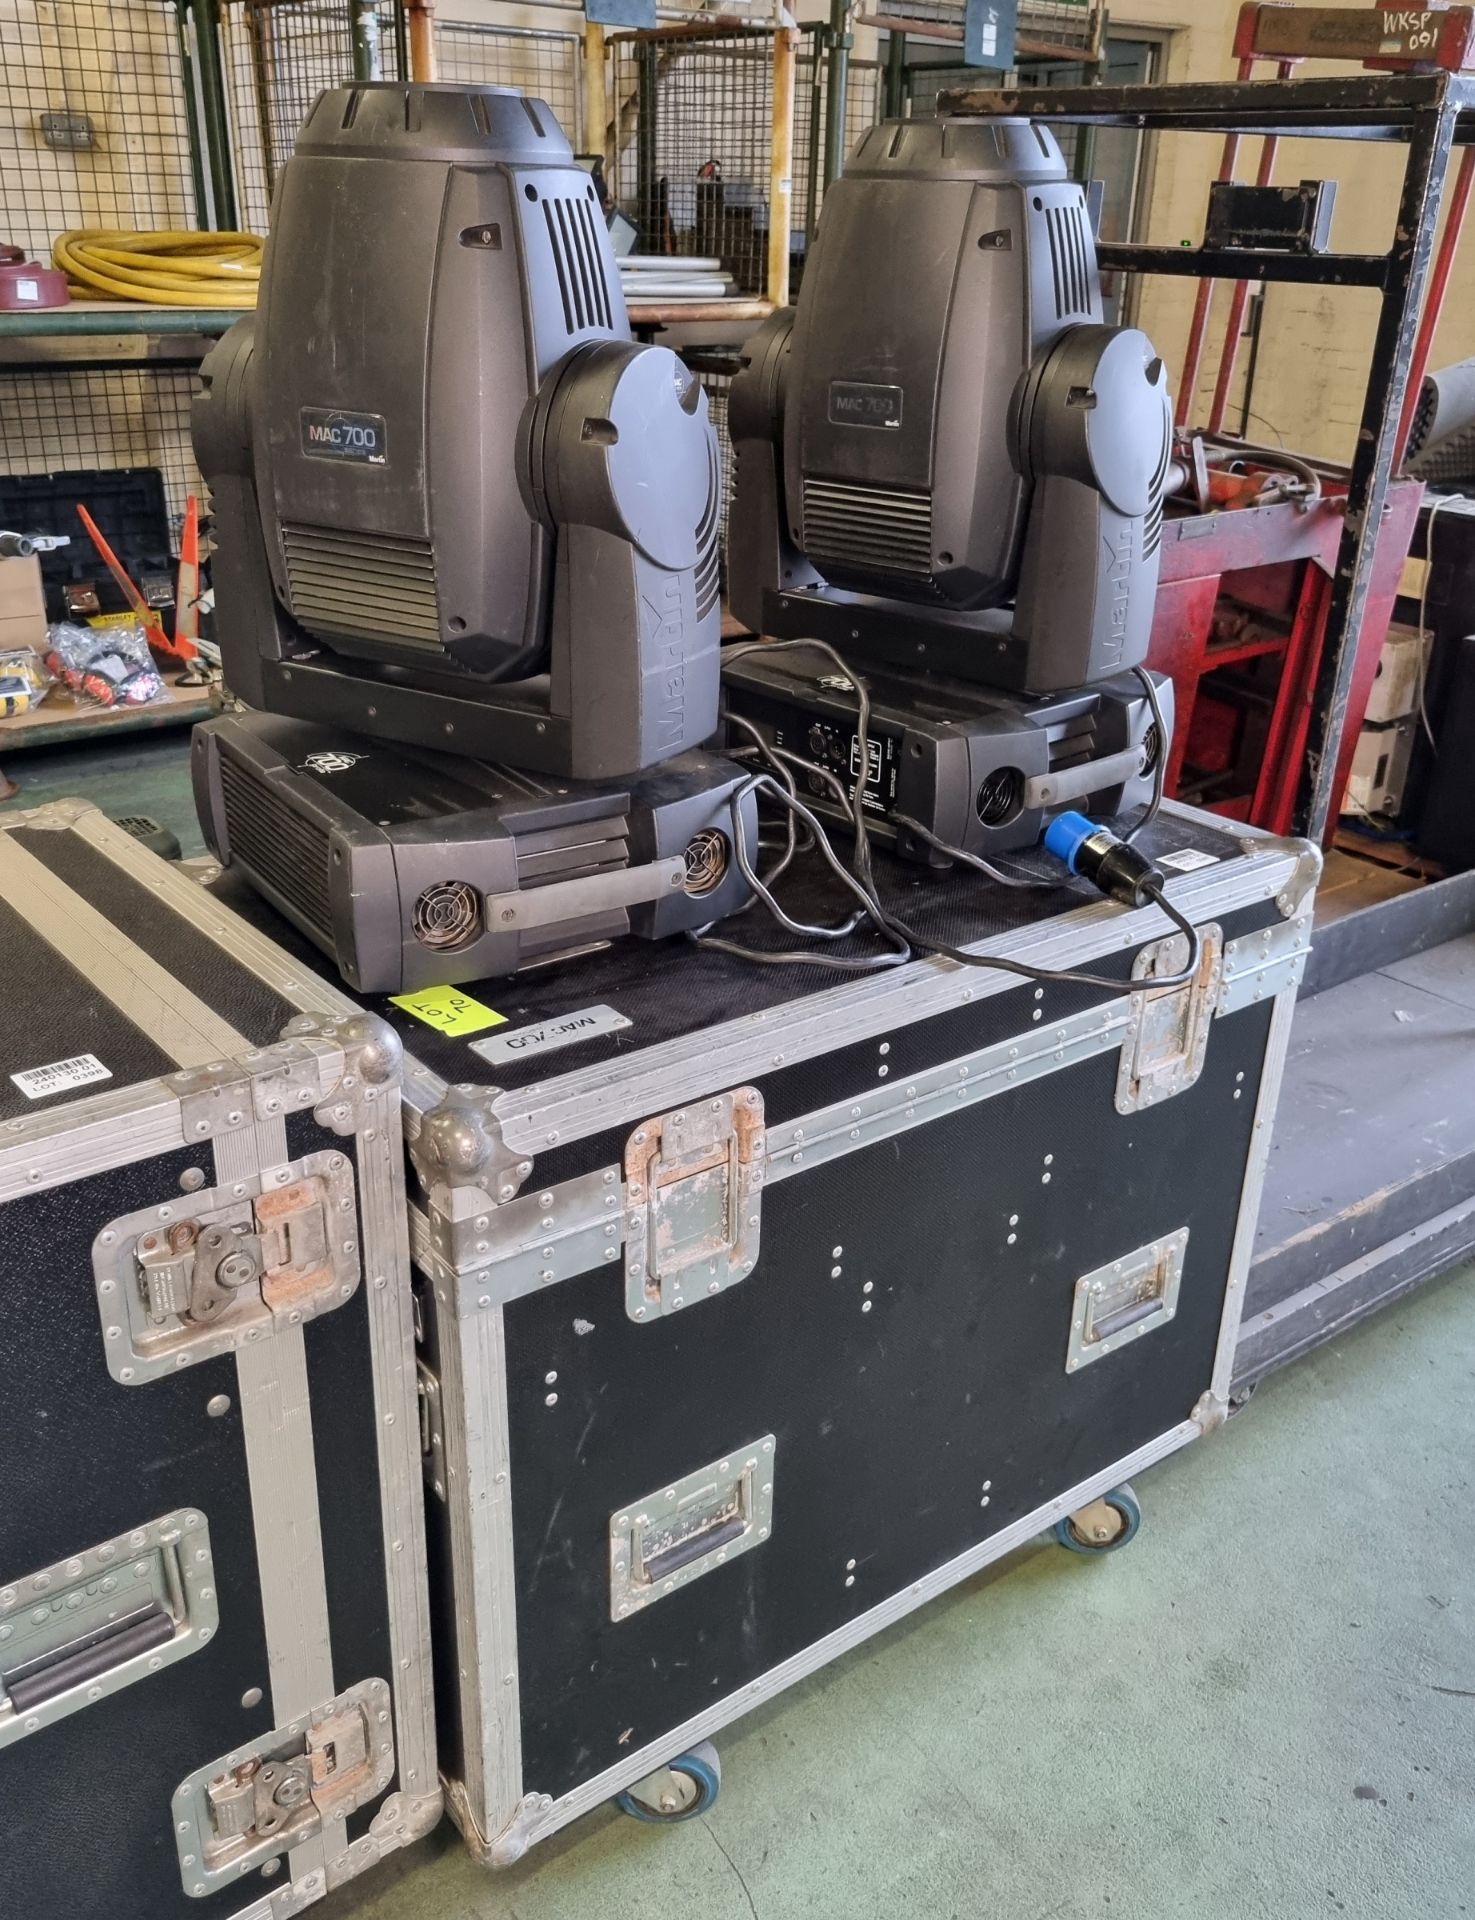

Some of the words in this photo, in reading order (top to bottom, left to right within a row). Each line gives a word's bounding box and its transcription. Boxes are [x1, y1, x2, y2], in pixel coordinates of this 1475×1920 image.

[1383, 11, 1432, 35] WKSP
[1409, 27, 1438, 50] 091
[309, 424, 342, 444] MAC
[342, 426, 376, 448] 700
[1099, 519, 1134, 670] Martin
[642, 574, 686, 752] Martin
[411, 1003, 457, 1025] LOT
[450, 999, 472, 1014] 70
